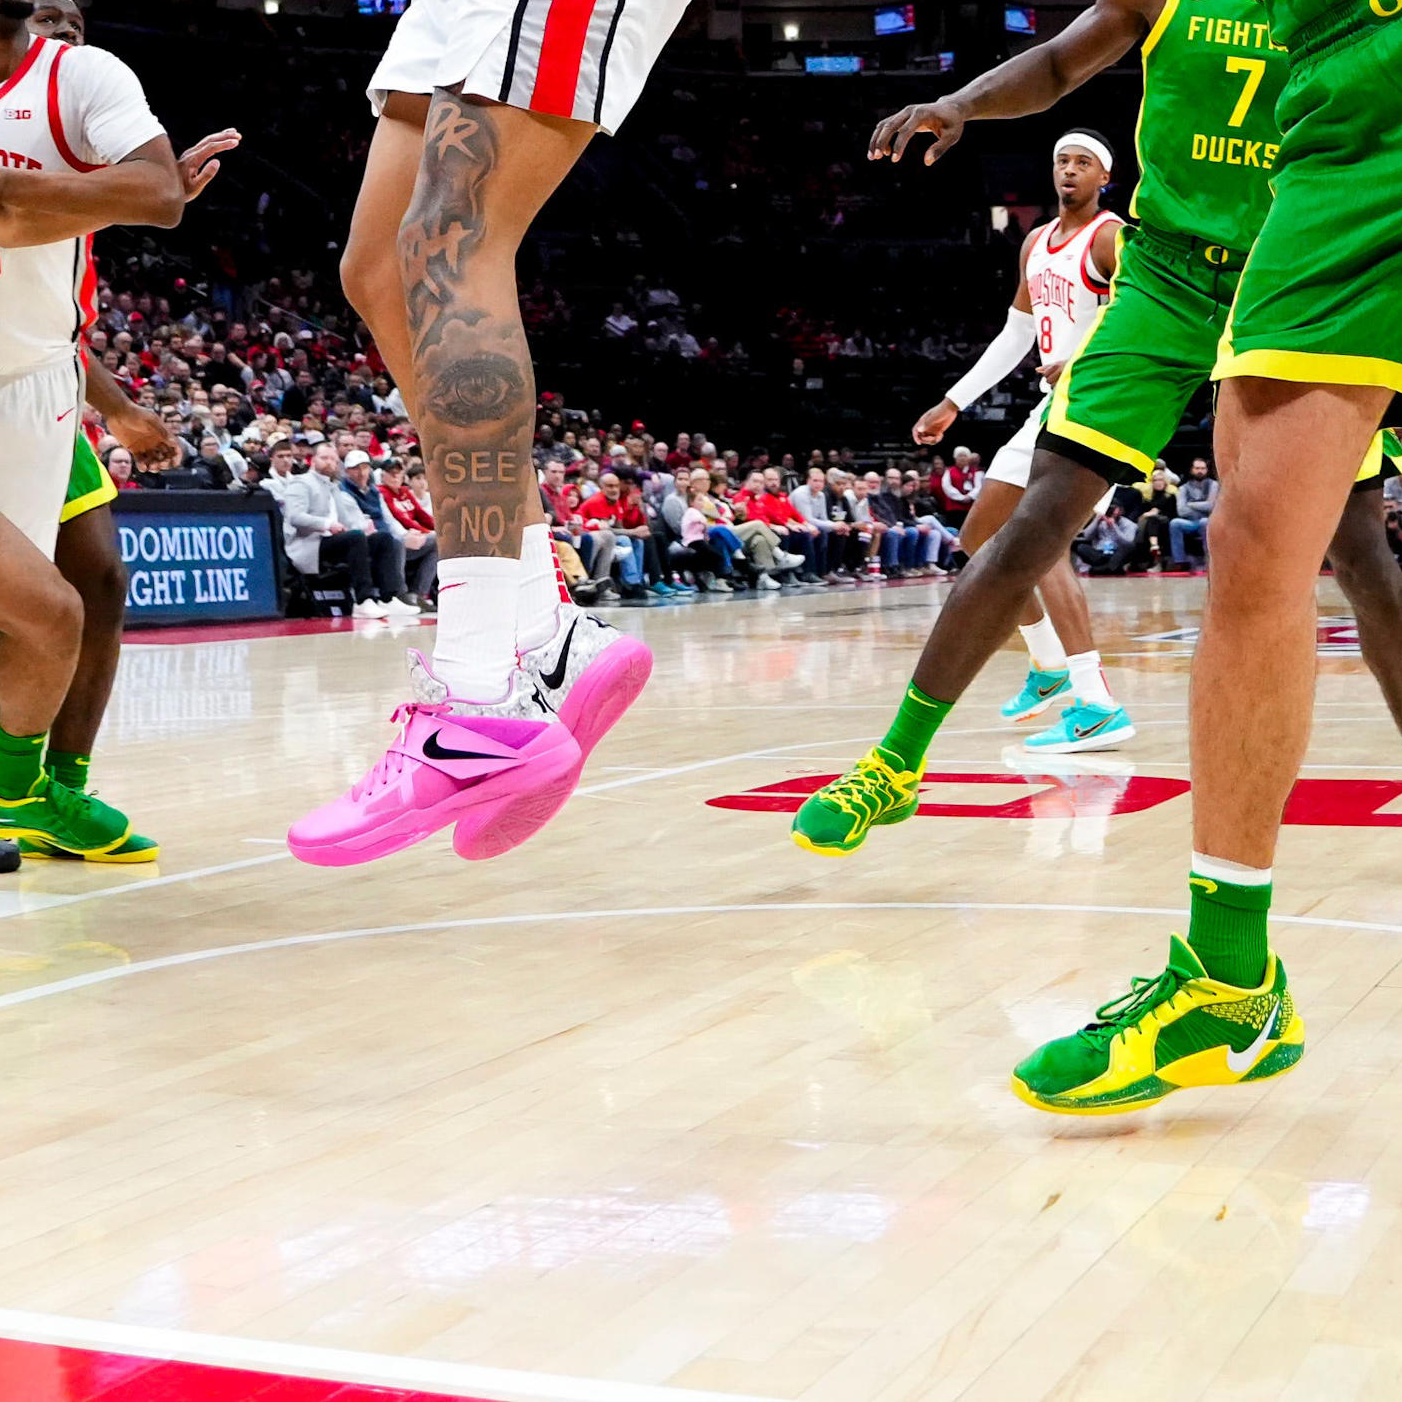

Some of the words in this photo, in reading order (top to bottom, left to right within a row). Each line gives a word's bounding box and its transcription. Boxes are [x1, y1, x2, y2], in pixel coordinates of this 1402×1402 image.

[1188, 14, 1288, 53] FIGHT
[1225, 55, 1267, 128] 7
[1191, 133, 1281, 170] DUCKS
[1040, 316, 1052, 354] 8
[444, 450, 518, 484] SEE
[460, 505, 506, 544] NO
[120, 525, 254, 563] DOMINION
[192, 567, 250, 604] LINE
